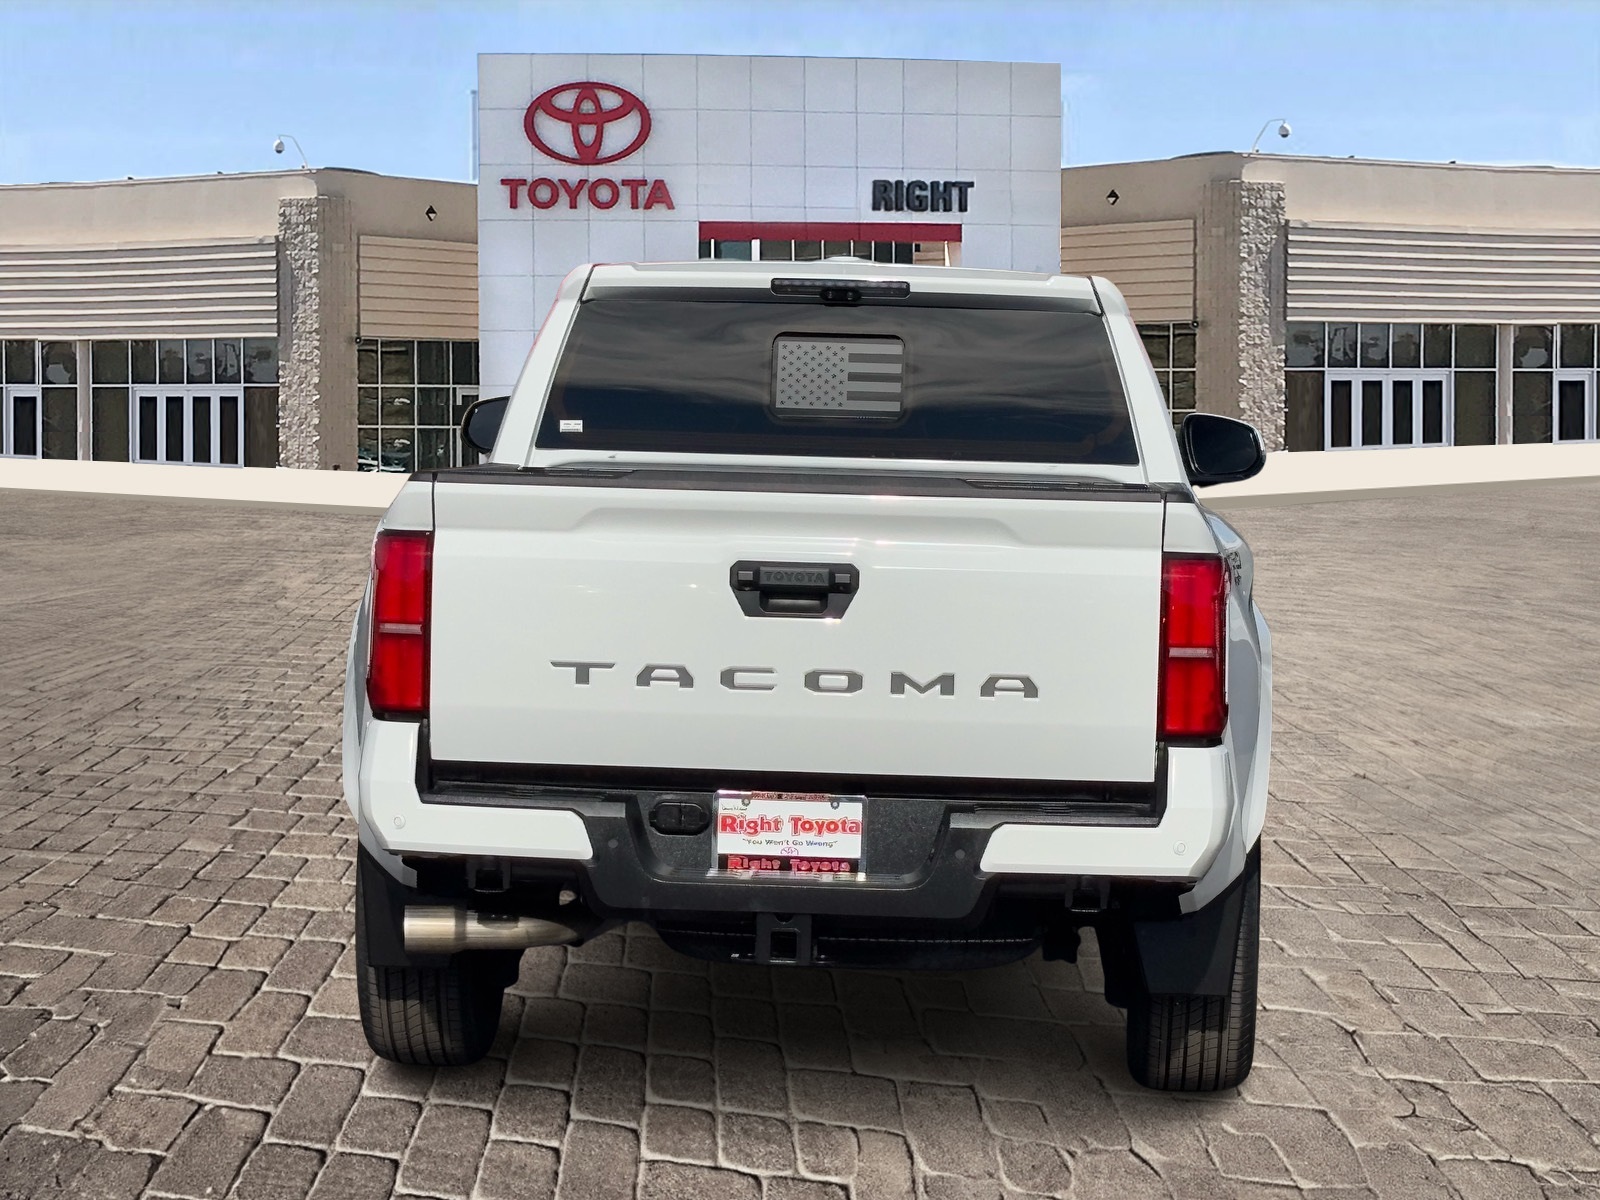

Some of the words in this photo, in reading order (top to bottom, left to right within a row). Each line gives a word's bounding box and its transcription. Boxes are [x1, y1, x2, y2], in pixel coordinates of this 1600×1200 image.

[500, 178, 675, 210] TOYOTA
[871, 179, 975, 212] RIGHT
[764, 570, 825, 583] TOYOTA
[550, 661, 1039, 699] TACOMA
[719, 813, 784, 836] Right
[789, 815, 863, 837] Toyota
[728, 854, 781, 871] Right
[789, 858, 851, 874] Toyota
